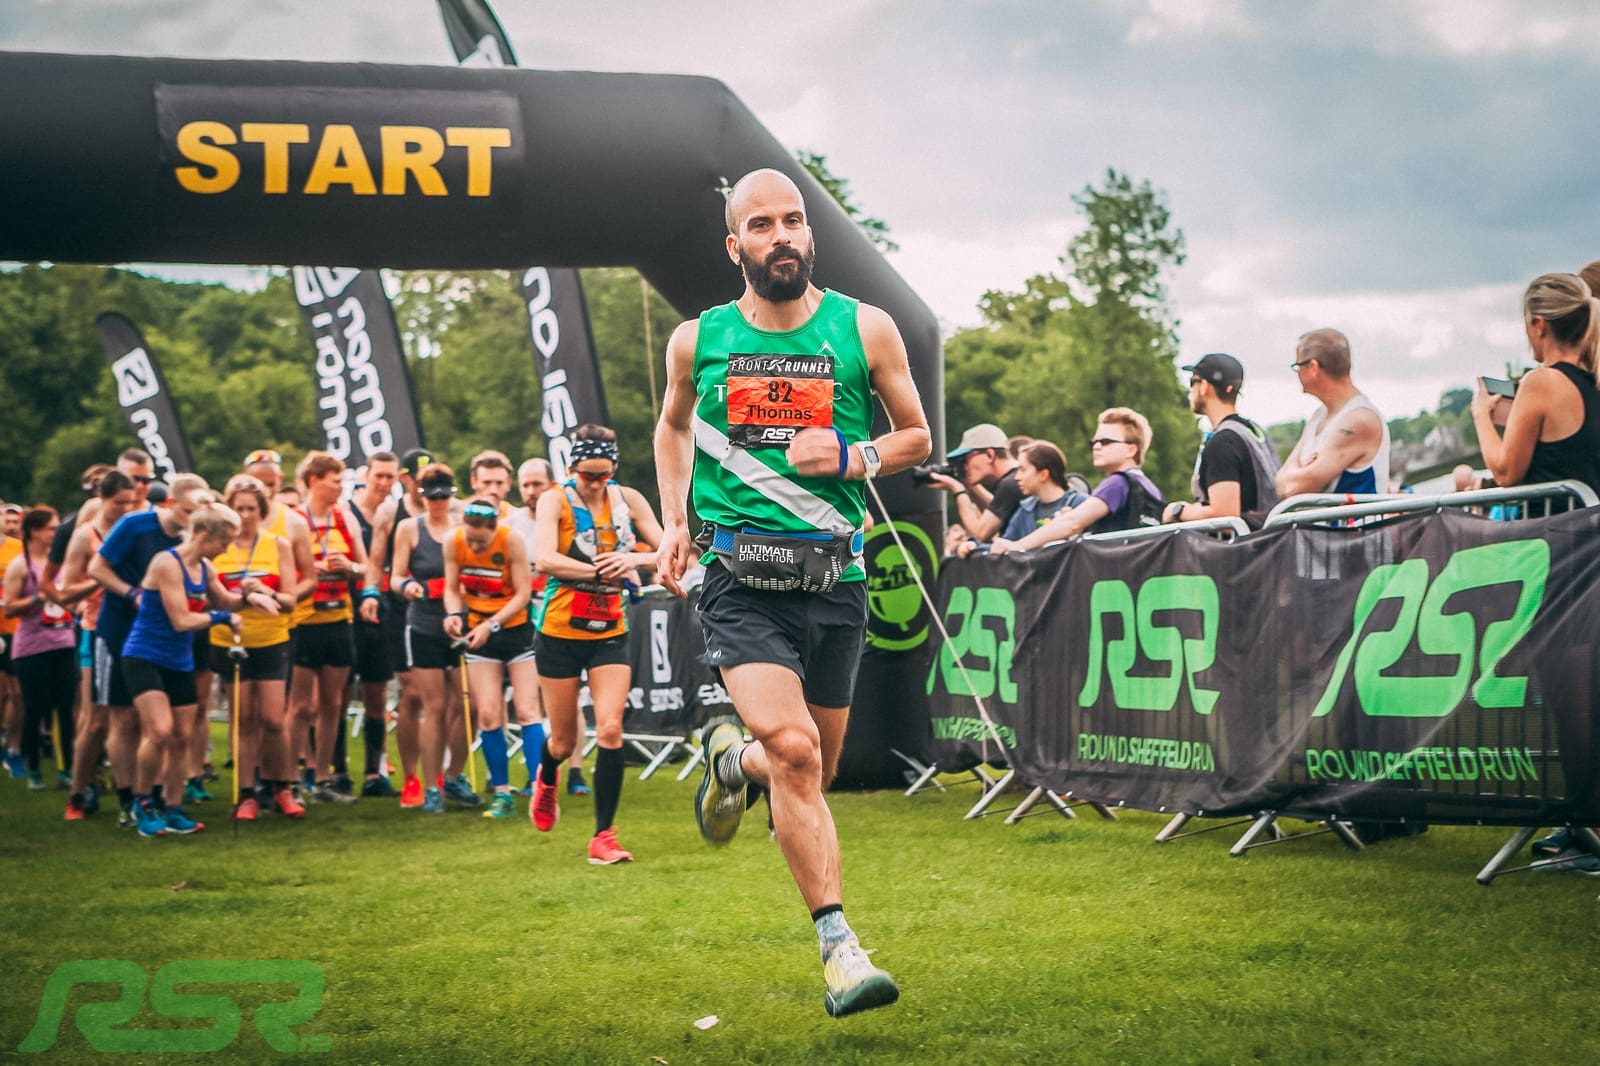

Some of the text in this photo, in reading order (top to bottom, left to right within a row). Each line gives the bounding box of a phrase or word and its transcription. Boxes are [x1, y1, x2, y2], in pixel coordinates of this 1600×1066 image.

[174, 120, 512, 197] START
[730, 358, 832, 374] FRONT RUNNER
[767, 380, 794, 404] 82
[746, 404, 813, 421] Thomas
[738, 553, 795, 565] DIRECTION
[739, 544, 795, 558] ULTIMATE
[1311, 537, 1551, 718] RSR
[1077, 573, 1221, 716] RSR
[1077, 733, 1128, 763] ROUND
[1128, 736, 1192, 770] SHEFFELD
[1305, 748, 1384, 782] ROUND
[1478, 746, 1540, 782] RUN
